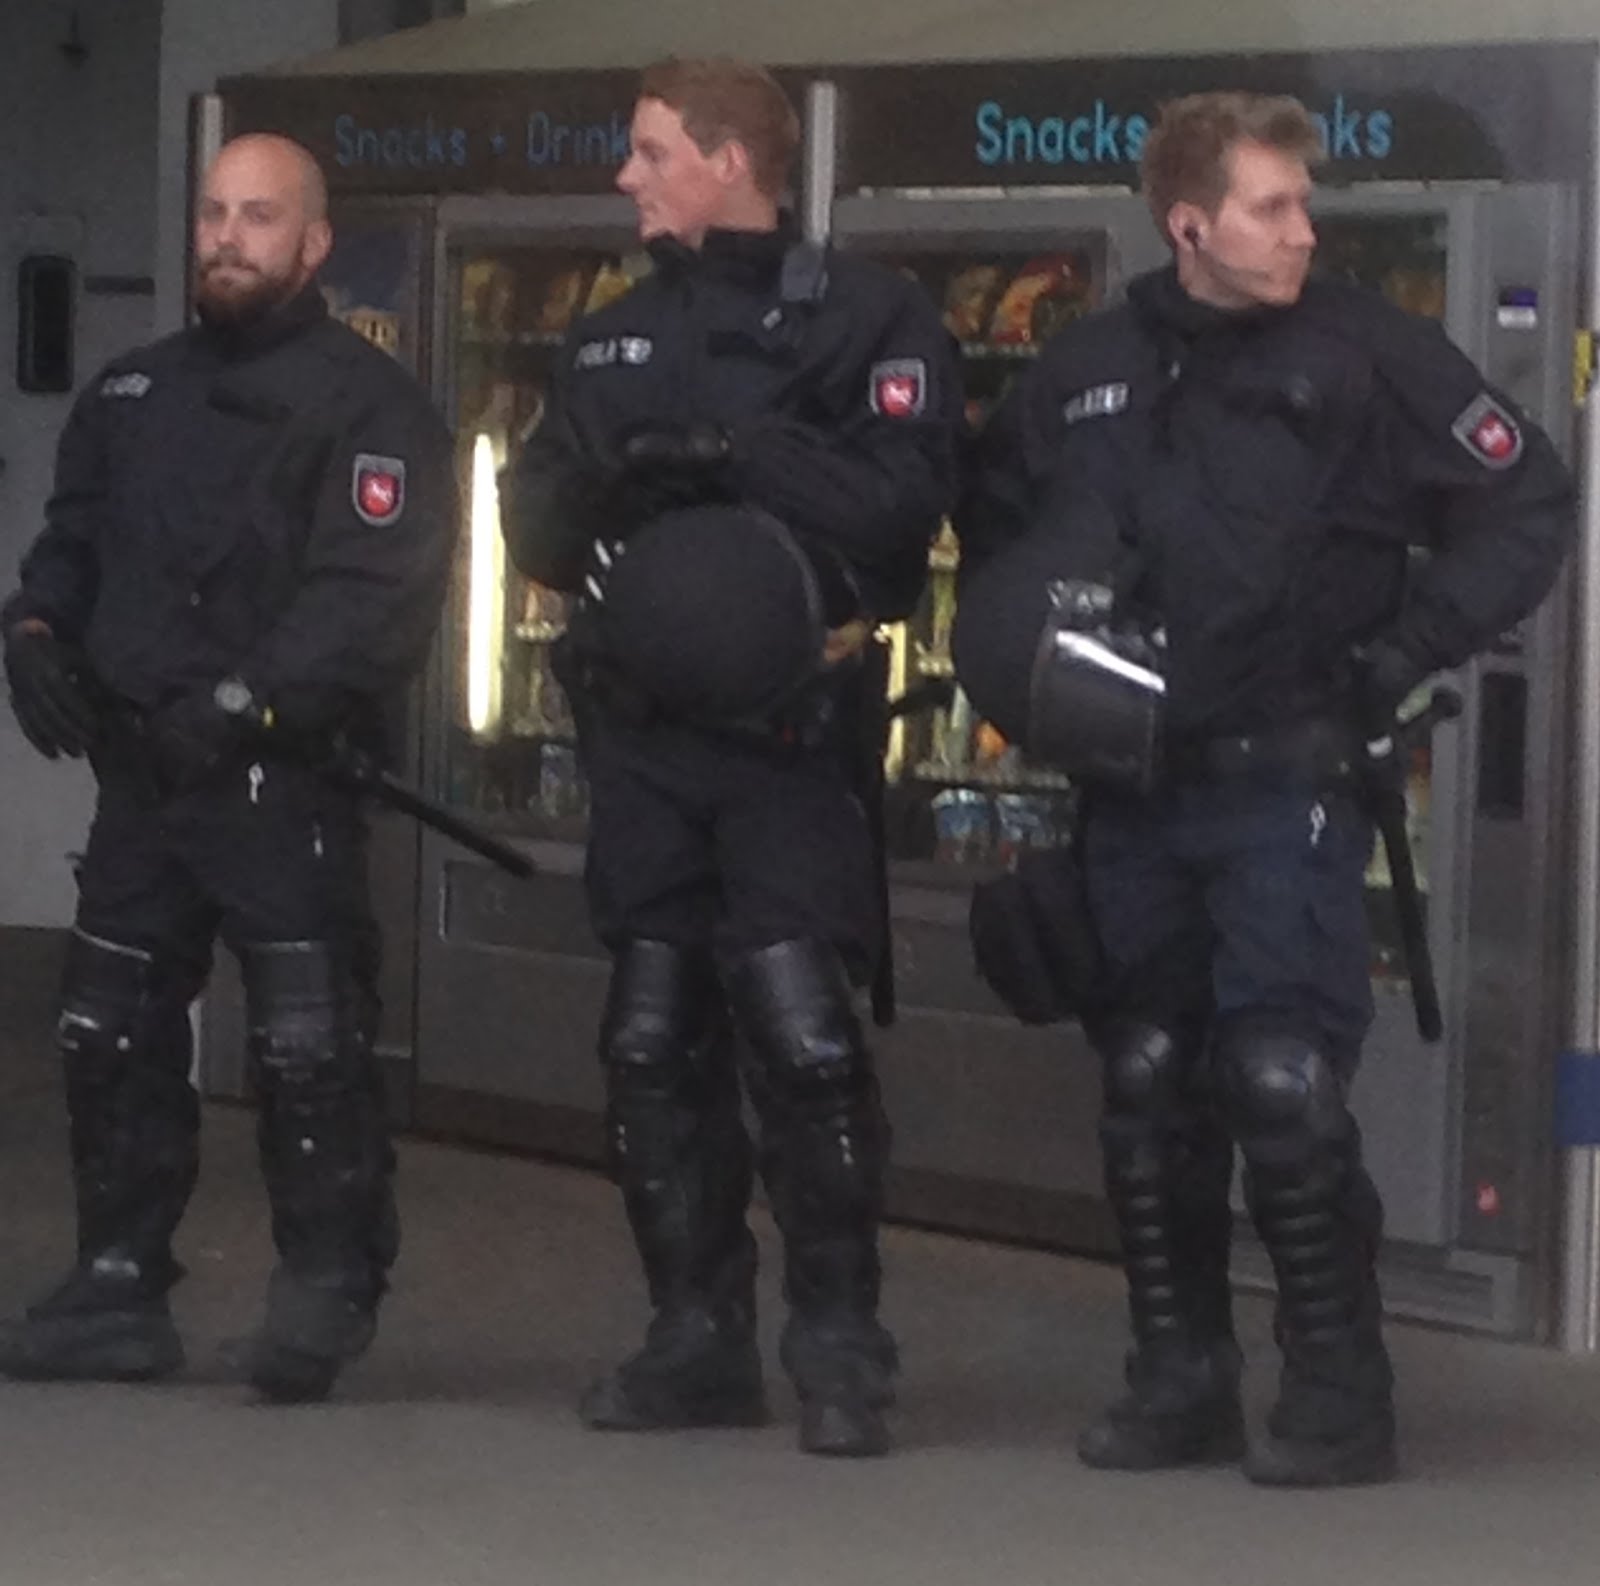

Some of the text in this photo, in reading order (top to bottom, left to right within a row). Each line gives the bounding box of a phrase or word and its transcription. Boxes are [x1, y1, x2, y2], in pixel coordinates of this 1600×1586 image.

[335, 113, 467, 168] Snacks
[527, 110, 631, 167] Drink
[976, 95, 1393, 165] Snacks nks
